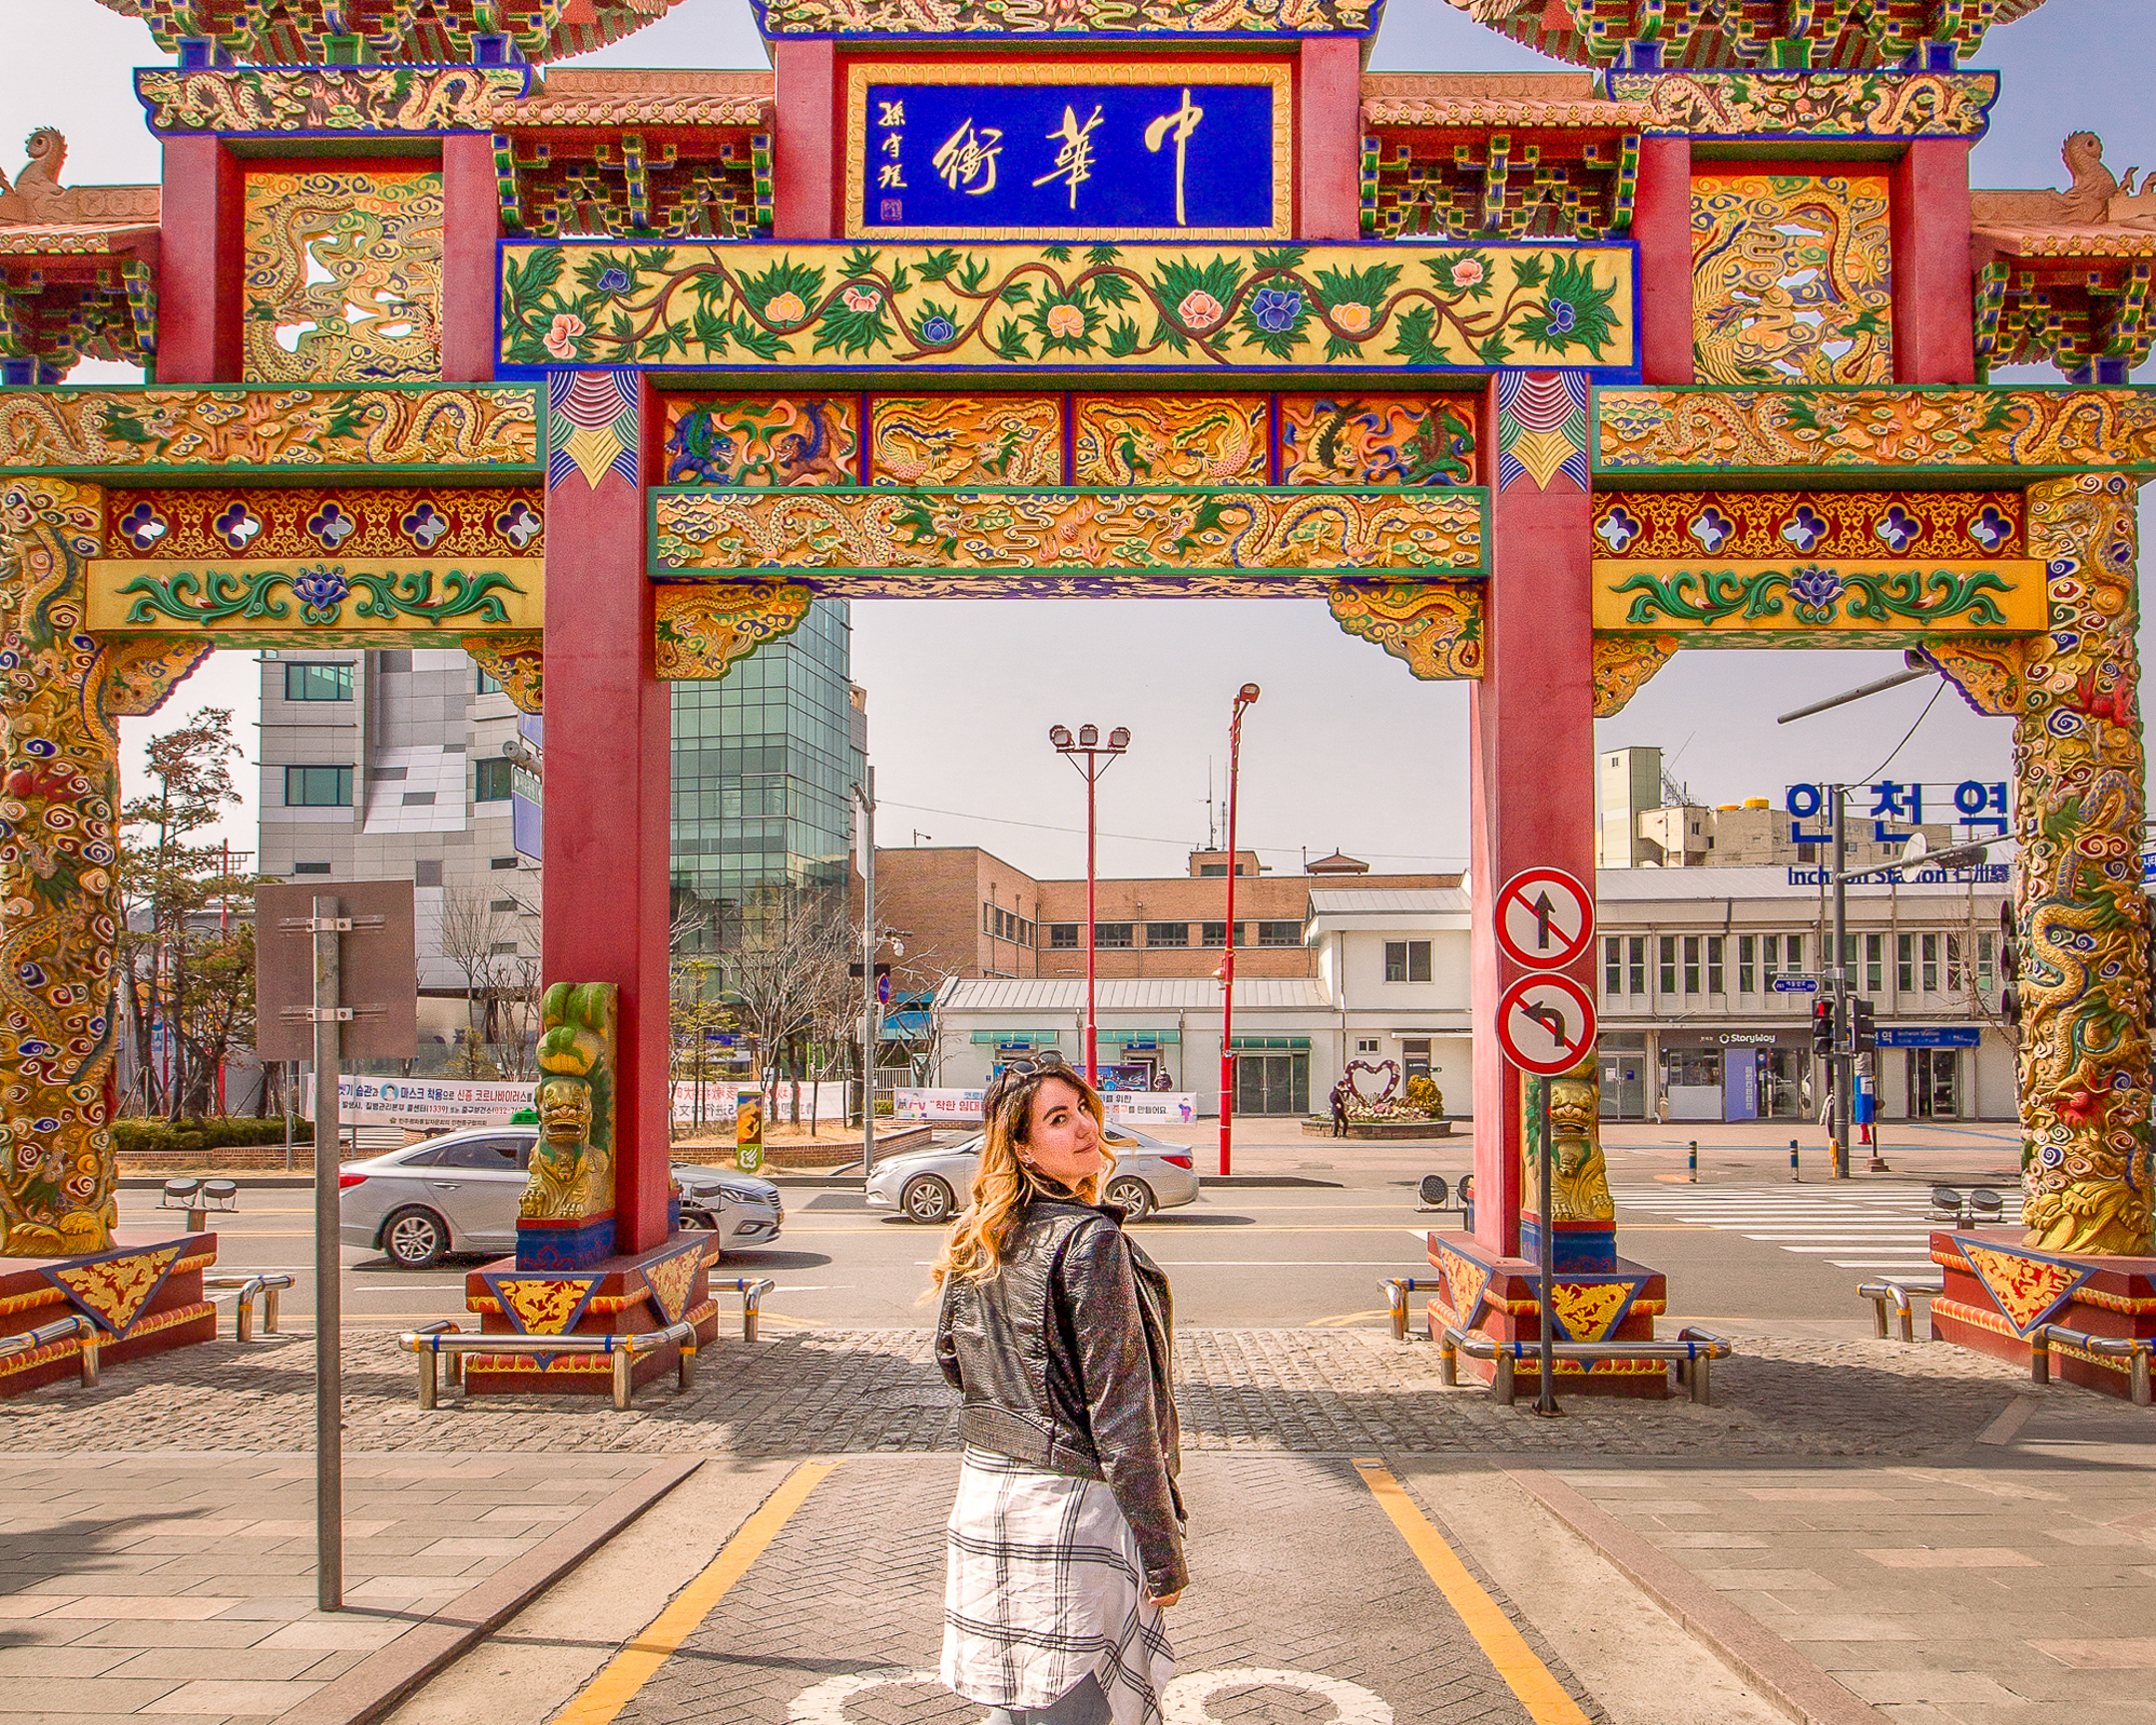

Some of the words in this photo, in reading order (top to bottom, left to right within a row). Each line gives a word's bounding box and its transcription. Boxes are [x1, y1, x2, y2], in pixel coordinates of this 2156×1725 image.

[1787, 781, 2008, 844] 인천역
[1788, 865, 1869, 885] Inchon
[1875, 867, 1946, 884] Staion
[355, 1084, 378, 1097] 습관과
[400, 1087, 425, 1100] 마스크
[427, 1088, 455, 1101] 착용으로
[457, 1089, 473, 1102] 신종
[474, 1089, 533, 1103] 코로나바이러스를
[1116, 1094, 1132, 1103] 위한
